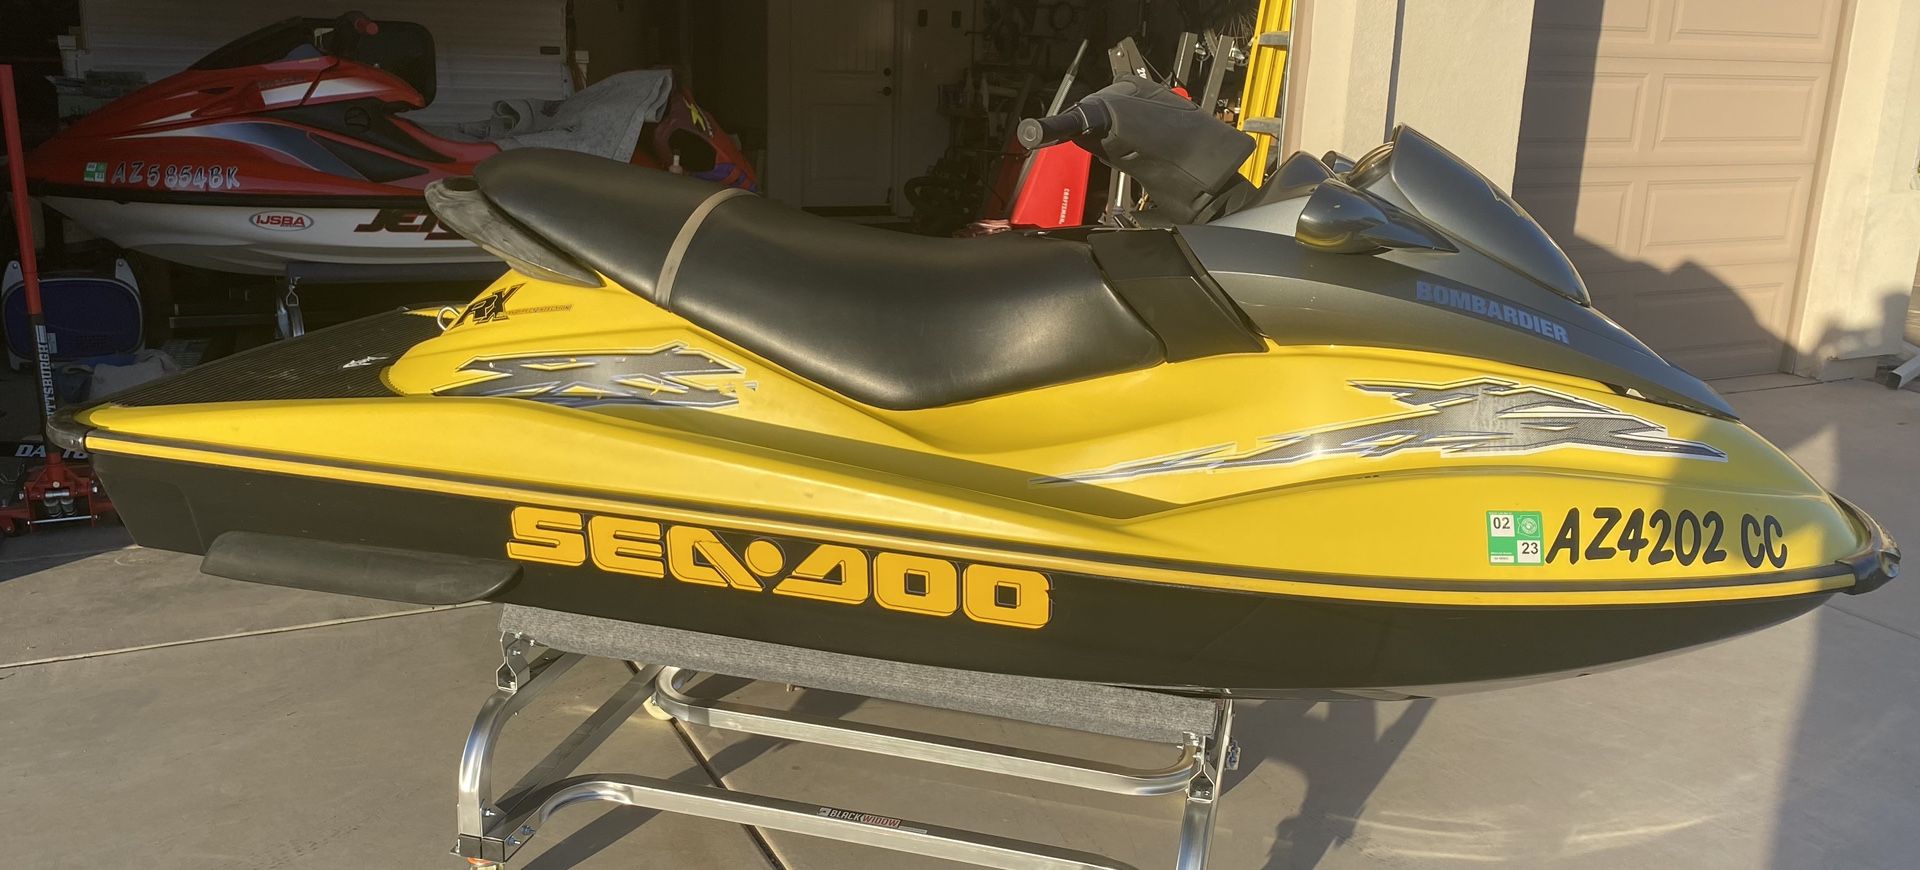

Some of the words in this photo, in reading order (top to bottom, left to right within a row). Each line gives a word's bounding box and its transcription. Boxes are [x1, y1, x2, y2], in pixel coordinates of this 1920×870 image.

[256, 215, 305, 225] IJSBA
[1416, 280, 1569, 344] BOMBARDIER
[38, 343, 56, 416] ITTSBURGH
[1493, 517, 1510, 529] 02
[1545, 507, 1728, 566] AZ4202
[1741, 513, 1788, 568] CC
[1521, 542, 1539, 555] 23
[829, 809, 861, 821] BLACK
